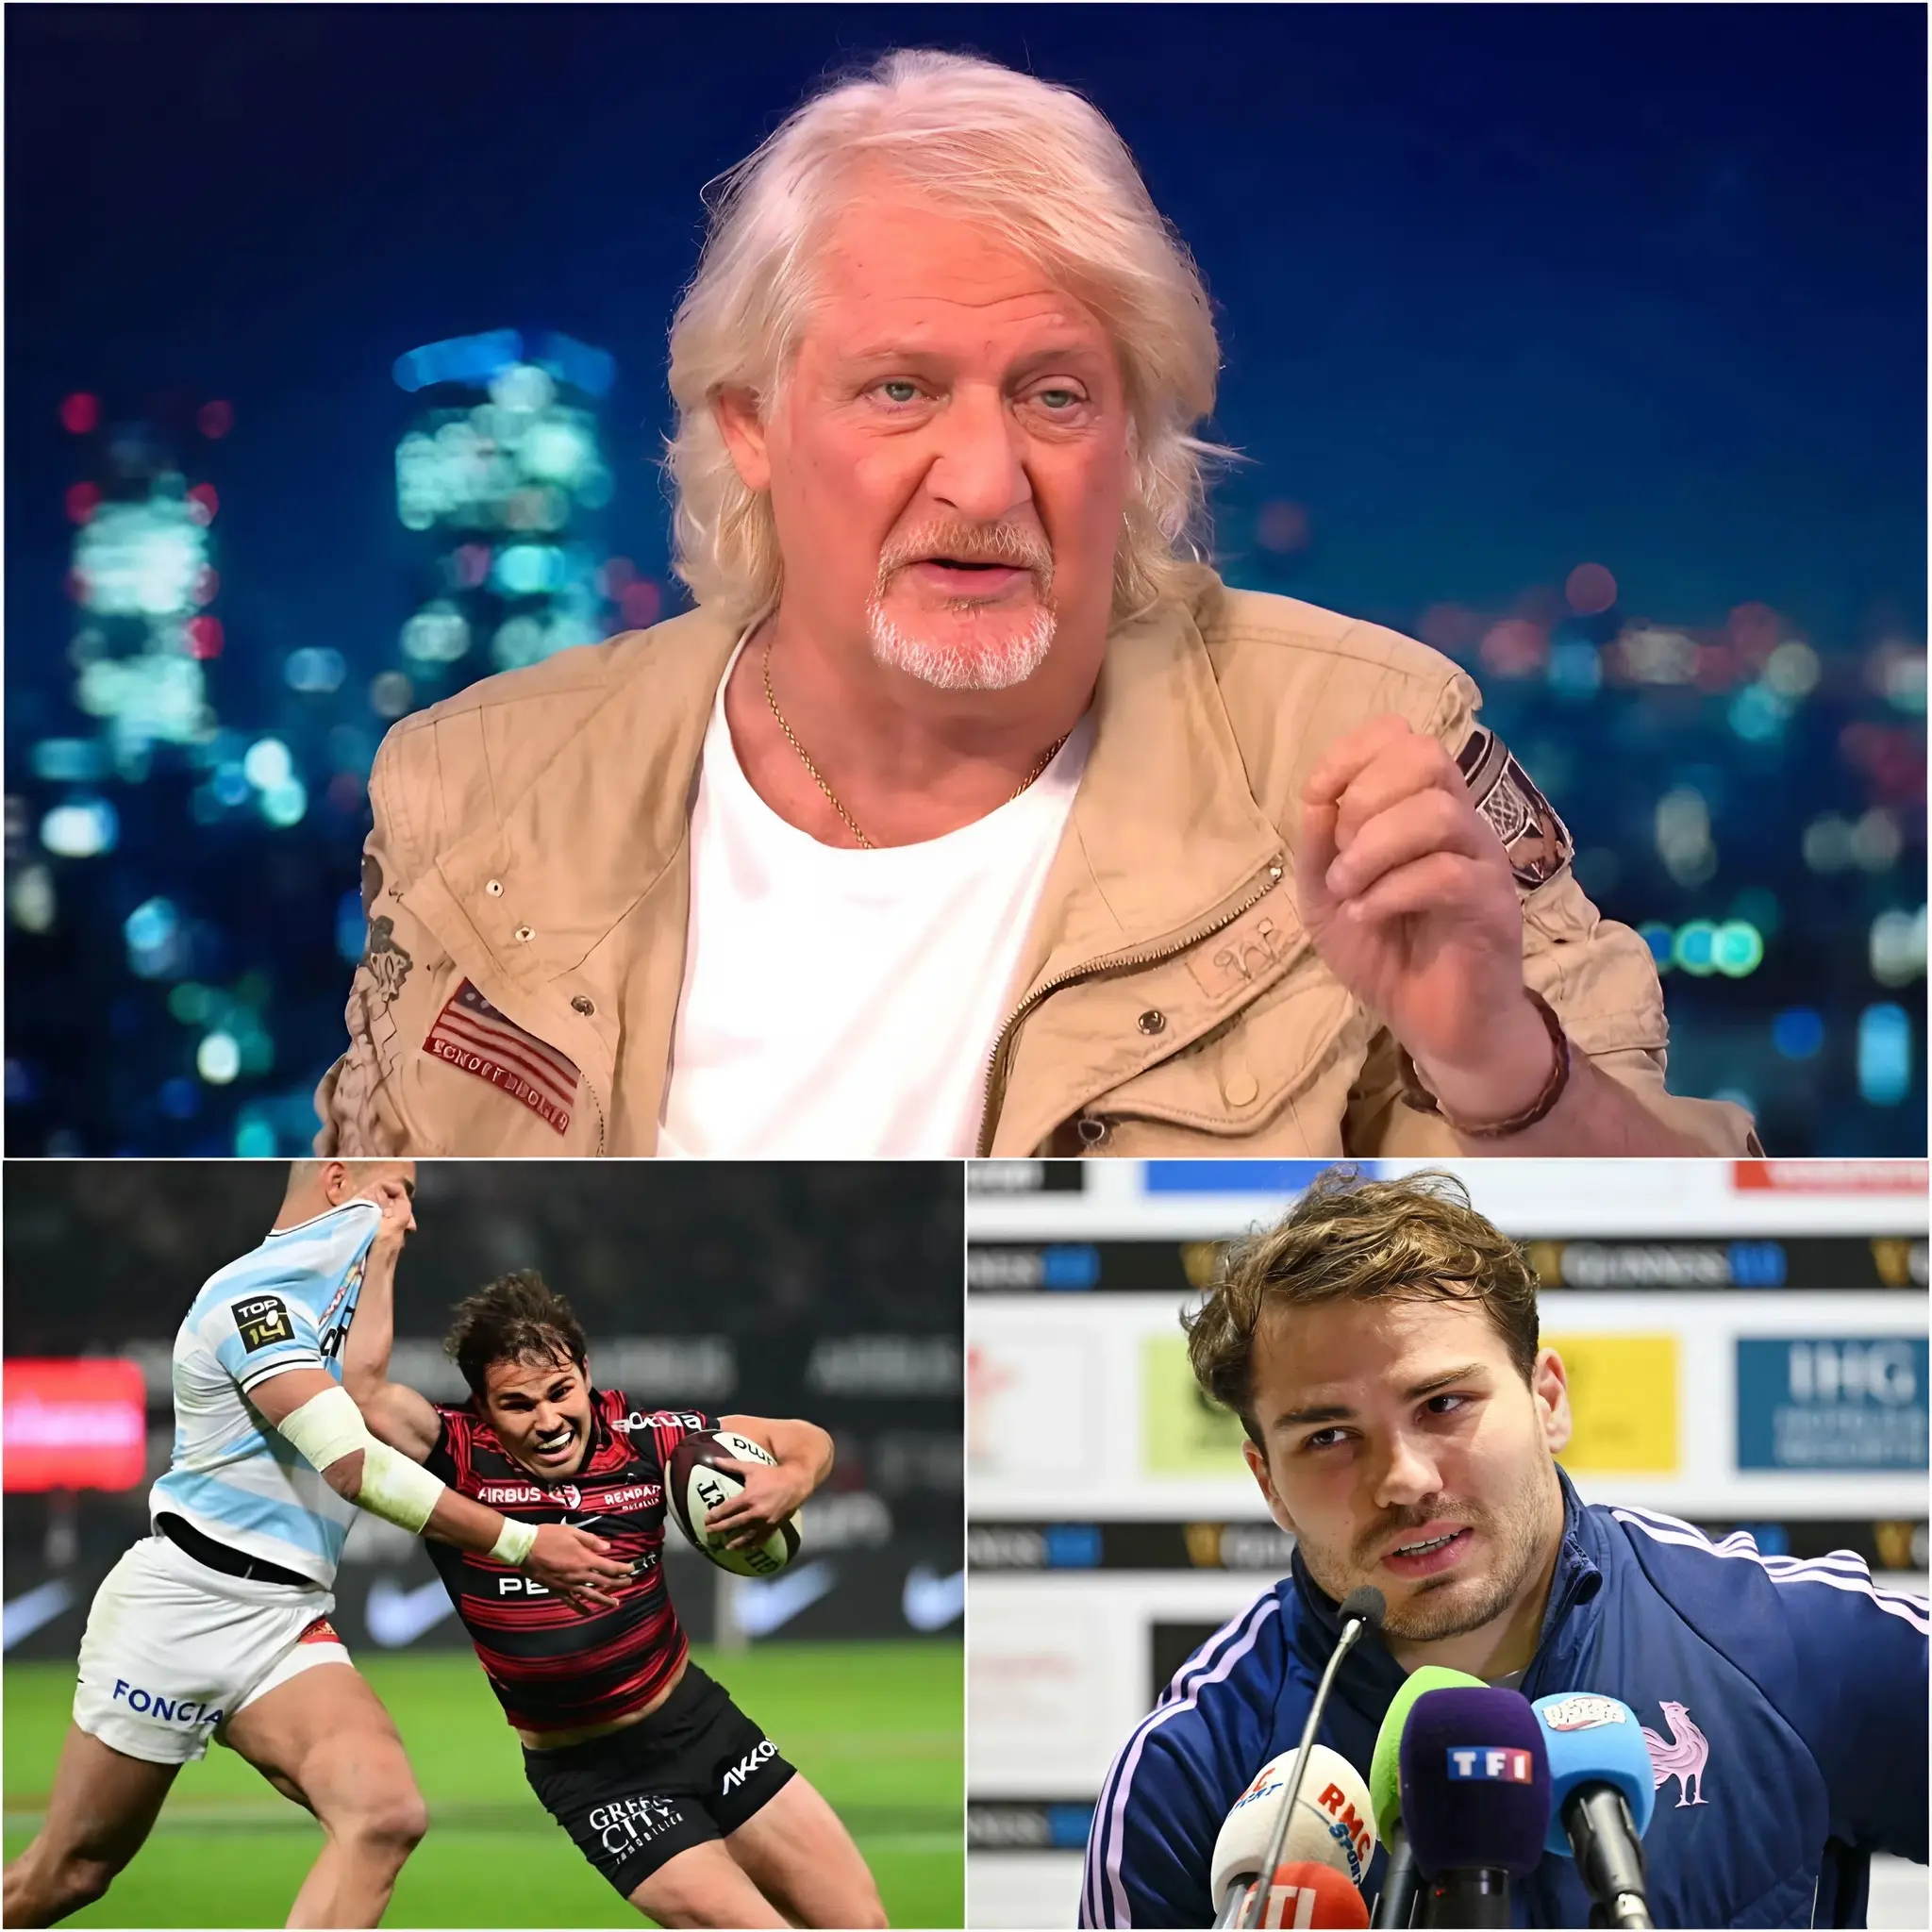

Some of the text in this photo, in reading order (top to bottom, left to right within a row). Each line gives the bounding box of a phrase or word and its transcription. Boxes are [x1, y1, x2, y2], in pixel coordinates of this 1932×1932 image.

[238, 1299, 279, 1318] TOP
[249, 1321, 286, 1345] 14
[477, 1486, 541, 1504] AIRBUS
[112, 1678, 224, 1725] FONCIA
[1318, 1783, 1371, 1862] RMC
